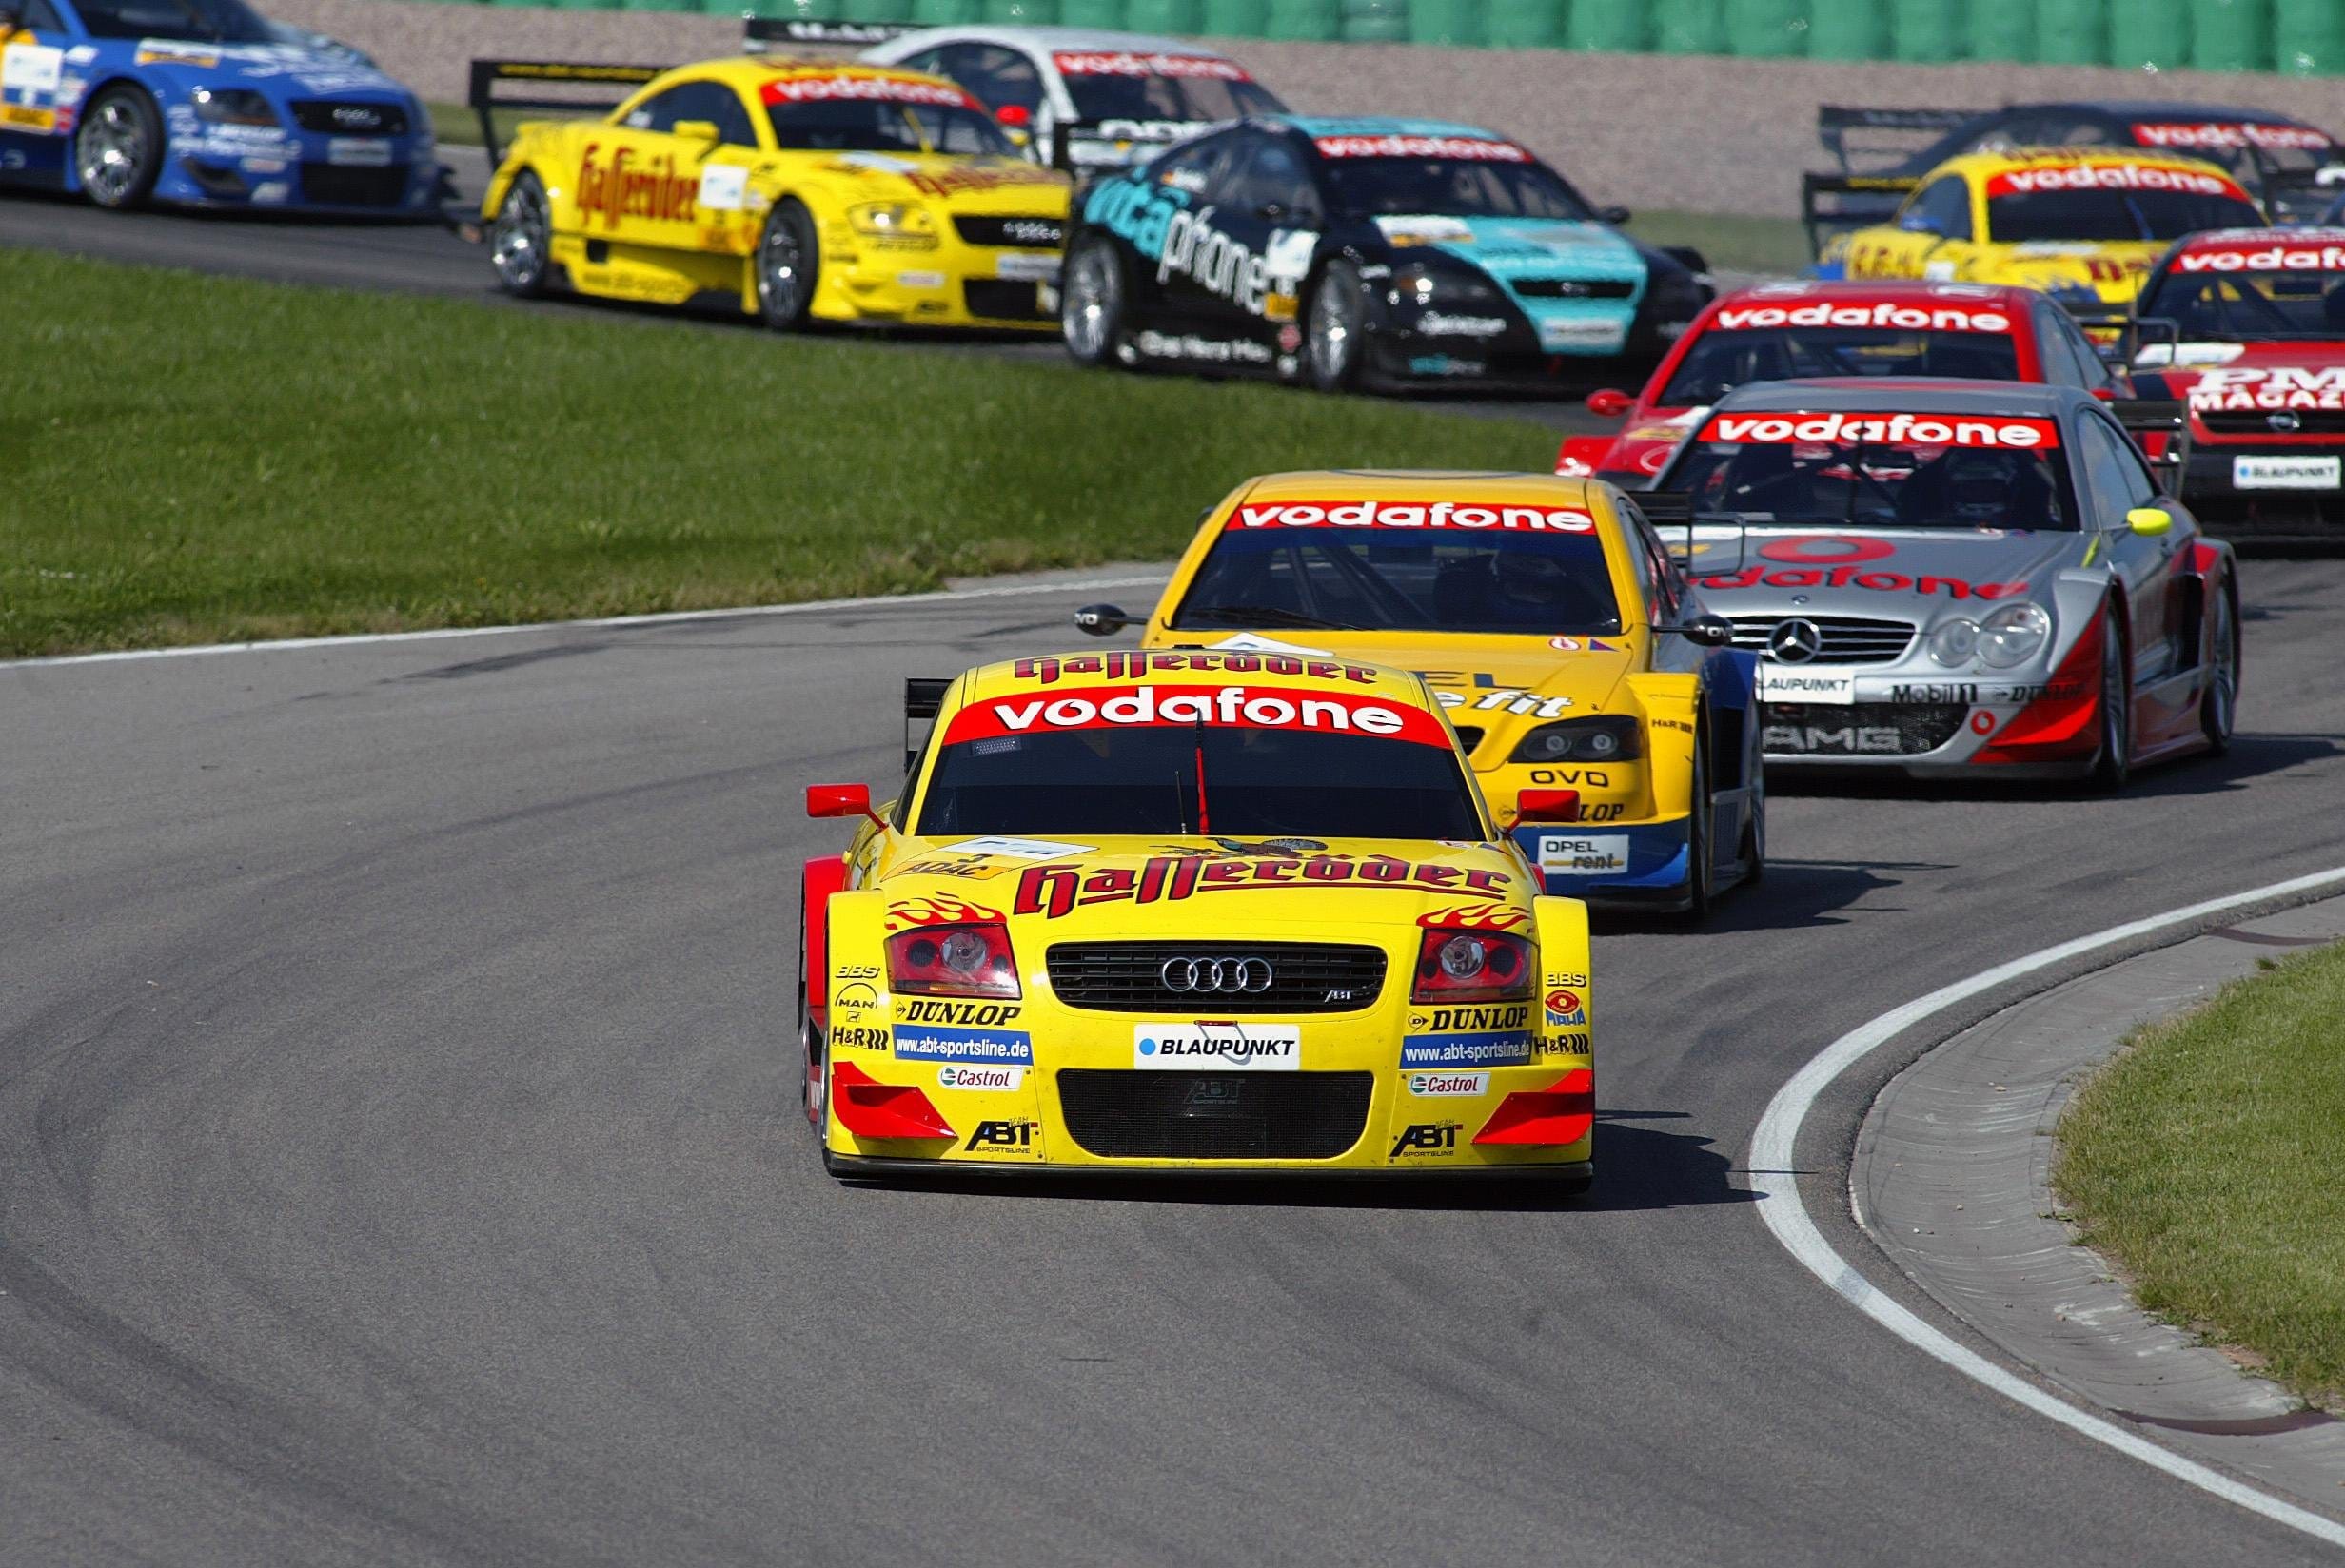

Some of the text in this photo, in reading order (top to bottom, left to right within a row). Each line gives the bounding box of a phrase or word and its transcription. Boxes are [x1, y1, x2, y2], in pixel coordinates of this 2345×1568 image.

[2005, 163, 2226, 194] vodafone
[2180, 247, 2345, 271] vodaf
[1718, 304, 2009, 331] vodafone
[1717, 414, 2041, 447] vodafone
[1241, 500, 1593, 532] vodafone
[1892, 685, 1951, 702] Mobil
[995, 686, 1404, 734] vodafone
[1763, 726, 1902, 751] AMG
[1530, 770, 1609, 788] OVD
[1580, 803, 1624, 821] LOP
[1546, 841, 1598, 853] OPEL
[907, 862, 988, 876] ADAC
[1572, 853, 1614, 869] rent
[836, 966, 880, 979] BBS
[1546, 972, 1586, 988] BBS
[839, 999, 875, 1009] MAN
[906, 1001, 1021, 1026] DUNLOP
[1429, 1007, 1528, 1031] DUNLOP
[896, 1036, 1029, 1058] www.abt-sportsline.de
[1159, 1039, 1295, 1056] BLAUPUNKT
[1405, 1040, 1530, 1062] www.abt-sportsline.de
[956, 1069, 1010, 1087] Castrol
[1428, 1076, 1478, 1092] Castrol
[964, 1120, 1039, 1151] ABT
[1389, 1124, 1464, 1157] ABT
